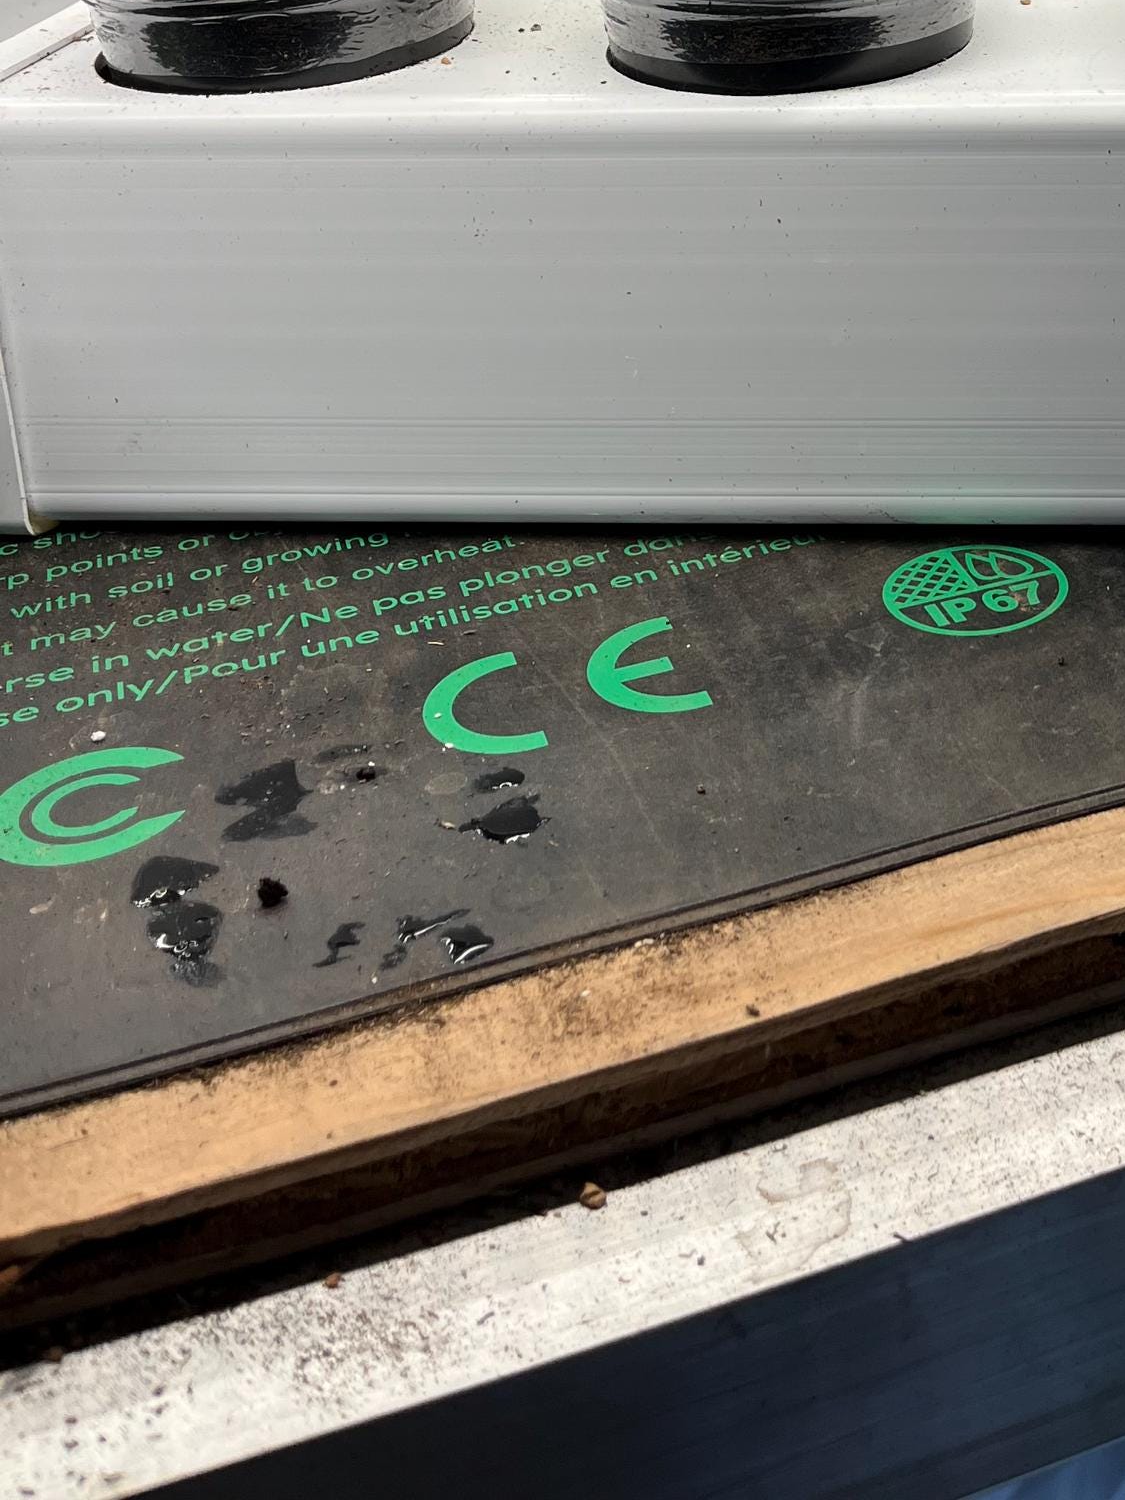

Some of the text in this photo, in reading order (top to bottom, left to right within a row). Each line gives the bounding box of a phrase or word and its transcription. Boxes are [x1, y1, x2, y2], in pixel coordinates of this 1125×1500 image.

[10, 591, 92, 619] with
[108, 571, 175, 596] soil
[189, 563, 229, 582] or
[240, 531, 391, 575] growing
[46, 544, 164, 582] points
[177, 535, 217, 552] or
[30, 623, 117, 651] may
[132, 591, 253, 629] cause
[266, 582, 291, 600] it
[301, 574, 338, 592] to
[91, 654, 130, 674] in
[371, 584, 449, 618] pas
[457, 549, 607, 598] plonger
[300, 629, 380, 660] une
[393, 582, 599, 640] utilisation
[609, 567, 659, 590] en
